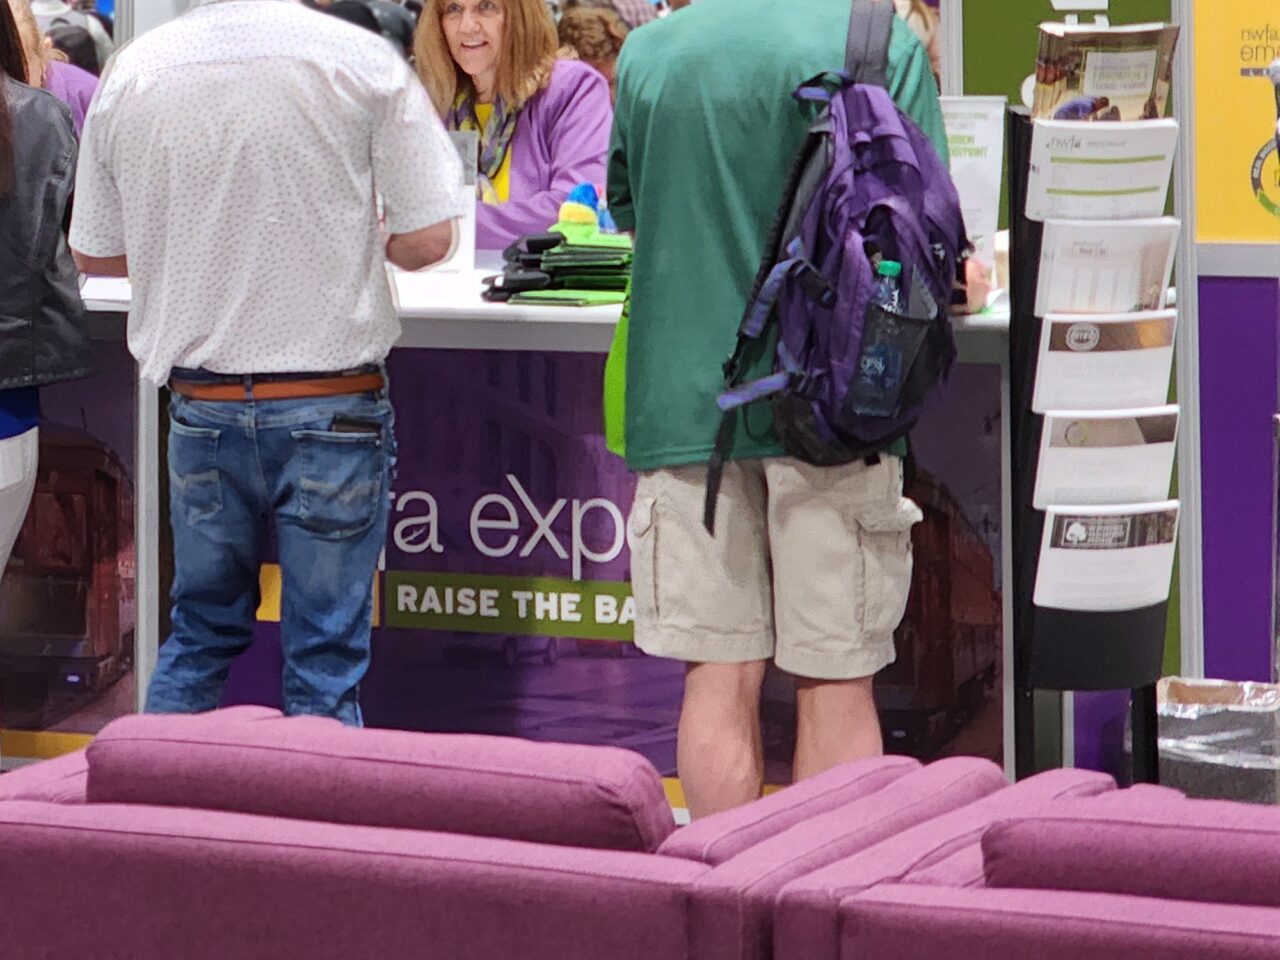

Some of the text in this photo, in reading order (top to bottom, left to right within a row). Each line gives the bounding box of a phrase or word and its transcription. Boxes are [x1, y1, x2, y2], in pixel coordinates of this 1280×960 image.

[470, 474, 634, 582] exp
[397, 584, 500, 618] RAISE
[512, 591, 583, 621] THE
